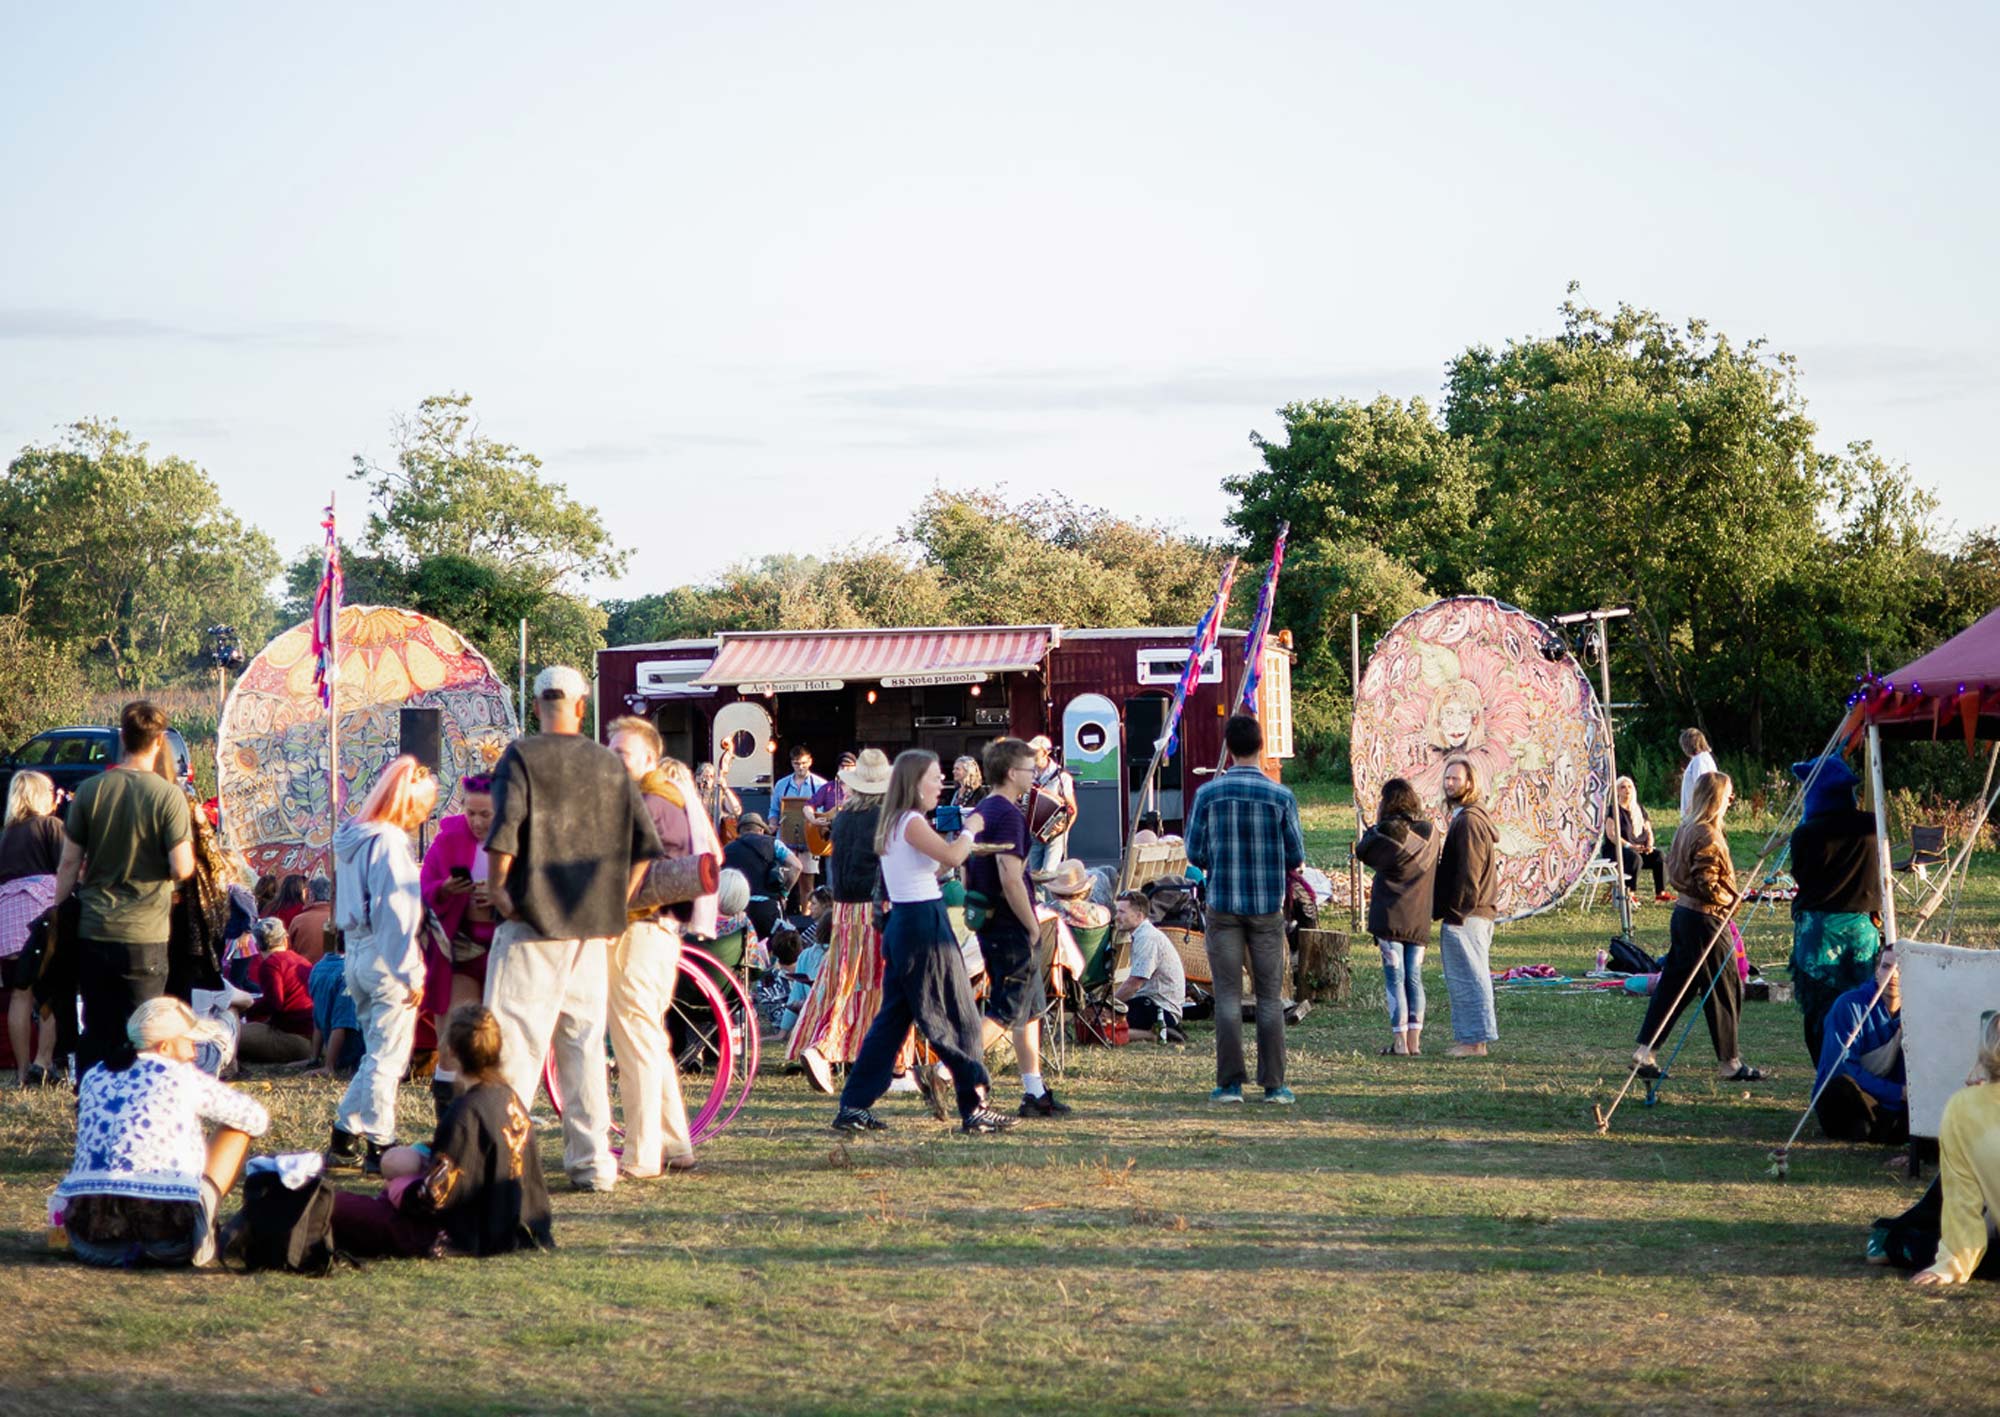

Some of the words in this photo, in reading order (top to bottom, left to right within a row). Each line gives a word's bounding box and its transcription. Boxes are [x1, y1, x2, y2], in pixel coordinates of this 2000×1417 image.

[805, 680, 831, 689] Holt
[891, 678, 906, 687] 88
[908, 676, 933, 685] Note
